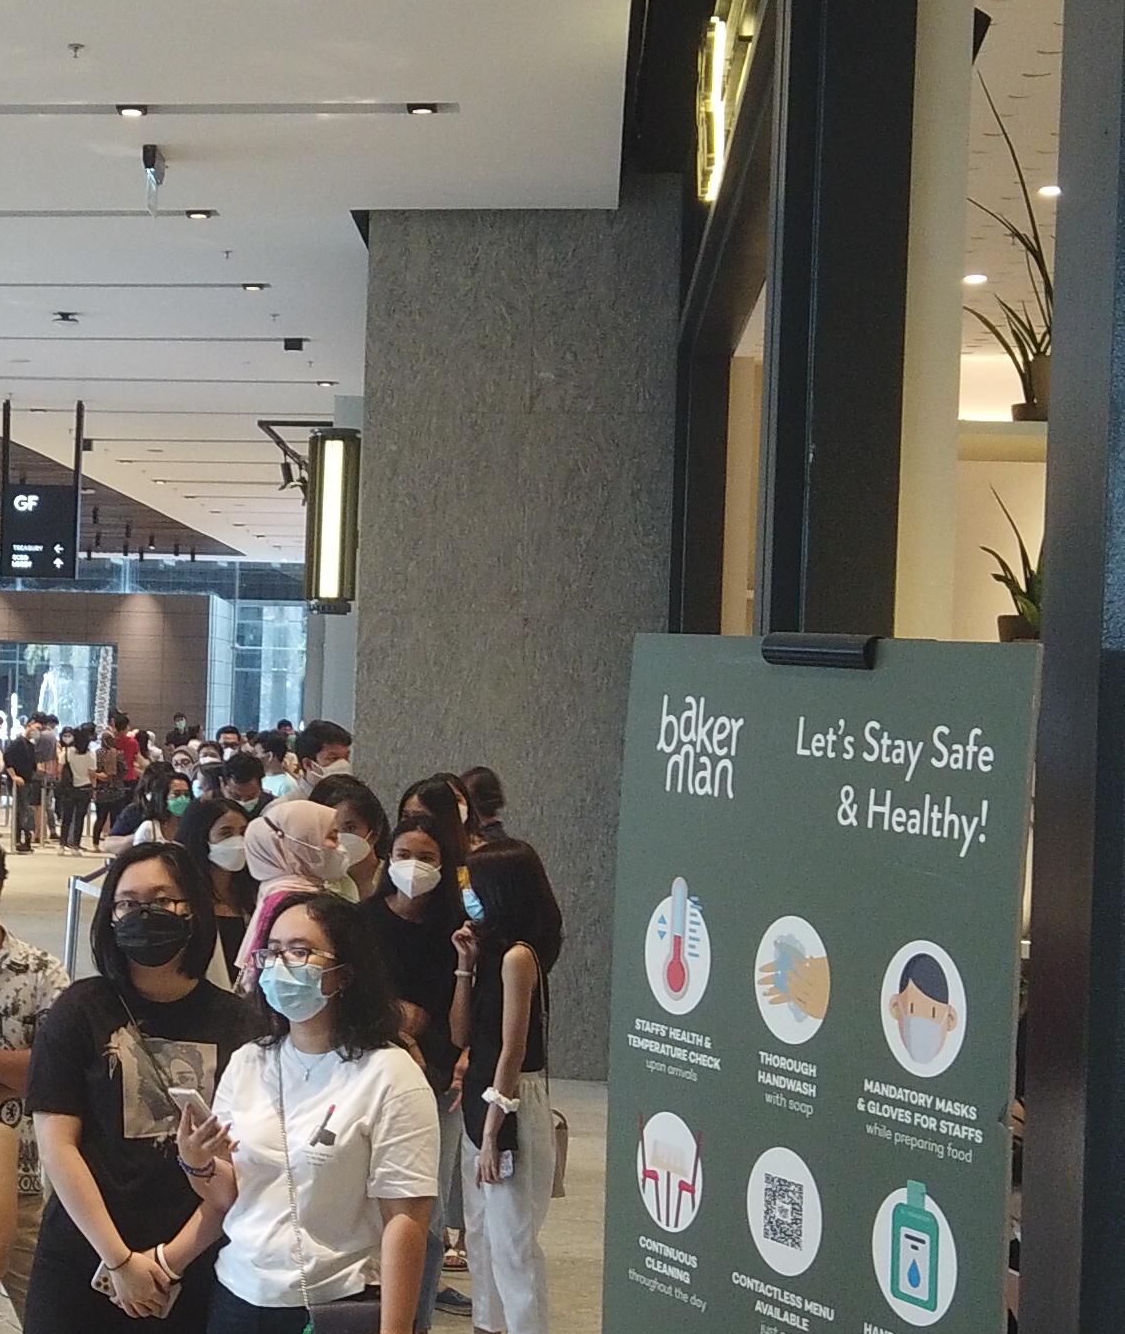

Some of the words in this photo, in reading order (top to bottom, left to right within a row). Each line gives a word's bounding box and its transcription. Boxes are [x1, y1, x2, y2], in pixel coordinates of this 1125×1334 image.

[13, 494, 39, 512] GF
[656, 694, 744, 757] baker
[796, 716, 855, 760] Let's
[862, 720, 924, 782] Stay
[930, 725, 995, 772] Safe
[666, 744, 734, 799] man
[837, 785, 858, 827] &
[867, 787, 989, 858] Healthy!
[627, 1034, 688, 1062] TEMPERATURE
[688, 1053, 722, 1071] CHECK
[669, 1026, 703, 1047] HEALTH
[704, 1036, 712, 1049] &
[645, 1059, 667, 1073] upon
[667, 1063, 698, 1082] arrivals
[758, 1051, 817, 1078] THOROUGH
[758, 1070, 817, 1098] HANDWASH
[864, 1078, 934, 1109] MANDATORY
[935, 1097, 978, 1121] MASKS
[764, 1091, 787, 1108] with
[788, 1099, 814, 1117] soap
[857, 1097, 866, 1112] &
[867, 1100, 912, 1124] GLOVES
[914, 1112, 938, 1132] FOR
[939, 1119, 983, 1144] STAFFS
[865, 1122, 893, 1140] while
[894, 1131, 945, 1159] preparing
[946, 1142, 973, 1163] food
[638, 1235, 698, 1268] CONTINUOUS
[645, 1256, 691, 1285] CLEANING
[628, 1268, 673, 1297] throughout
[674, 1286, 689, 1303] the
[689, 1293, 707, 1313] day
[731, 1271, 803, 1309] CONTACTLESS
[804, 1298, 835, 1321] MENU
[754, 1300, 809, 1332] AVAILABLE
